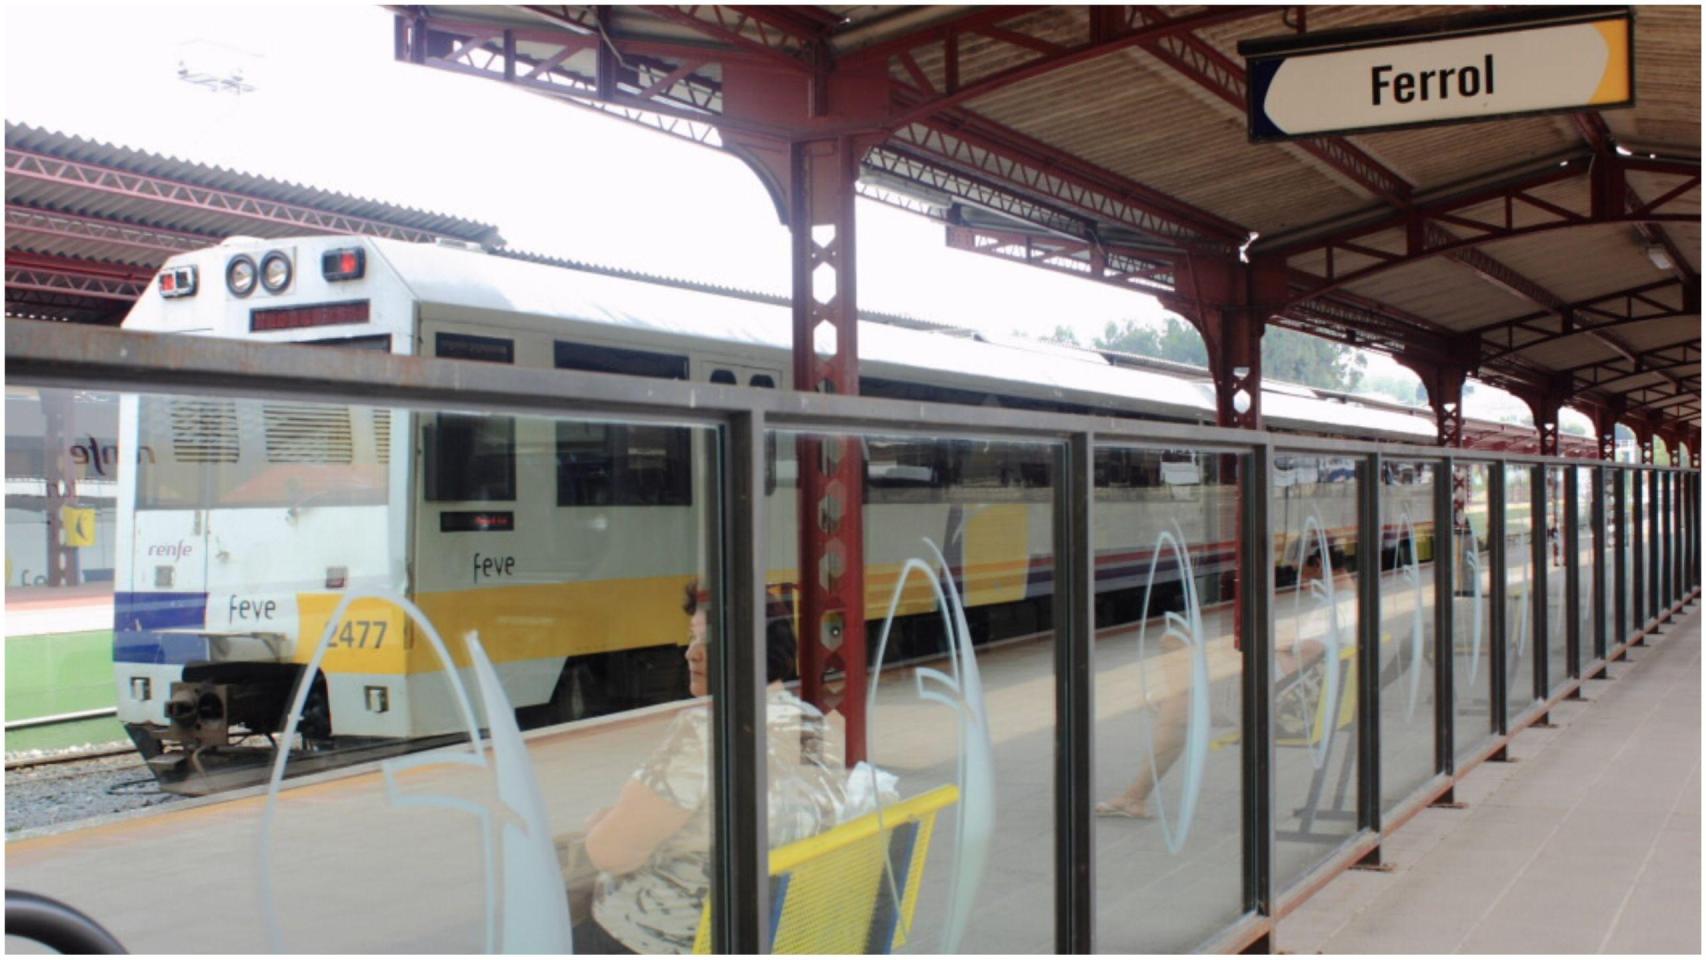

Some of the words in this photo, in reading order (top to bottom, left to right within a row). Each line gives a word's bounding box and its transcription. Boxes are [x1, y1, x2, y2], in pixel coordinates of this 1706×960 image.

[1371, 53, 1494, 106] Ferrol
[147, 540, 193, 562] renfe
[473, 552, 515, 584] feve
[229, 594, 277, 624] feve
